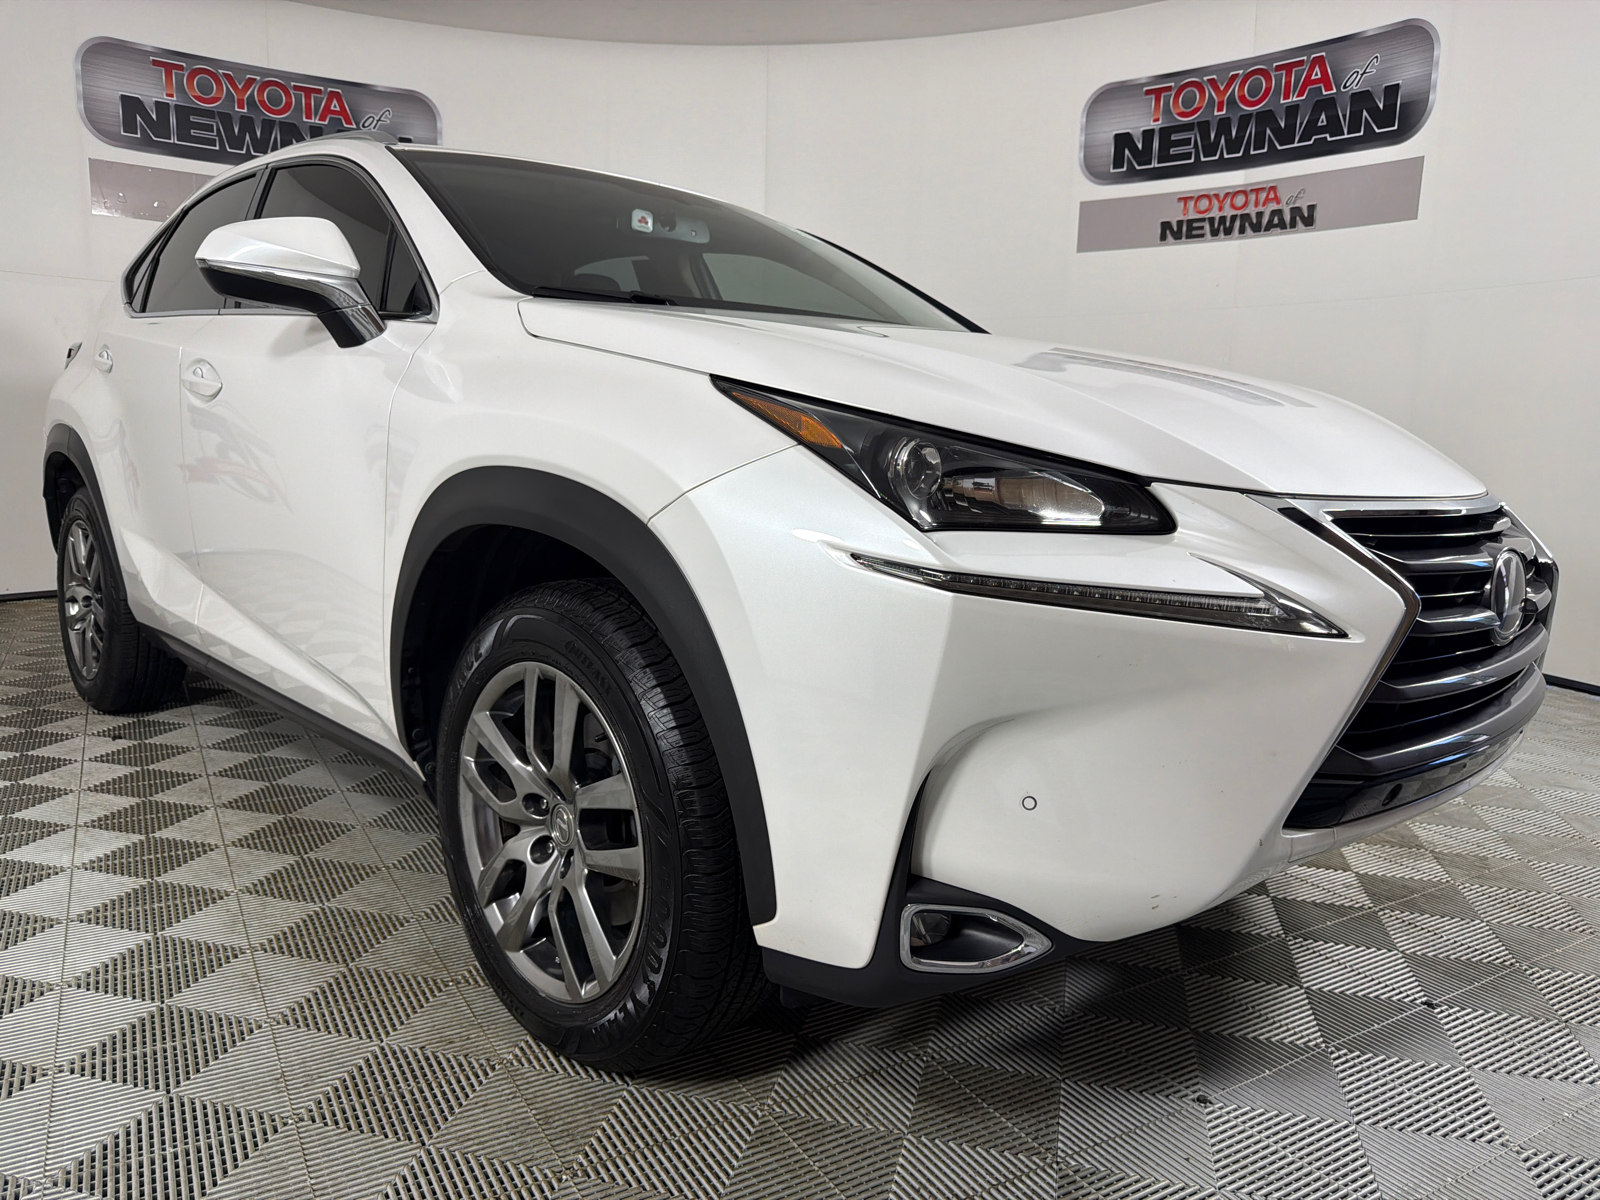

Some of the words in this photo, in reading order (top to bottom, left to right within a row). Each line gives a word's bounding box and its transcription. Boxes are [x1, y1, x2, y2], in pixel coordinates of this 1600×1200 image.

[150, 57, 355, 128] TOYOTA
[360, 108, 392, 130] of
[1144, 52, 1335, 125] TOYOTA
[1340, 53, 1381, 92] of
[119, 92, 412, 157] NEWN
[1110, 80, 1402, 173] NEWNAN
[1158, 202, 1318, 243] NEWNAN
[1177, 185, 1282, 217] TOYOTA
[1285, 188, 1306, 207] of
[564, 639, 613, 696] OUTLAST
[592, 865, 672, 1046] GOODYEAR
